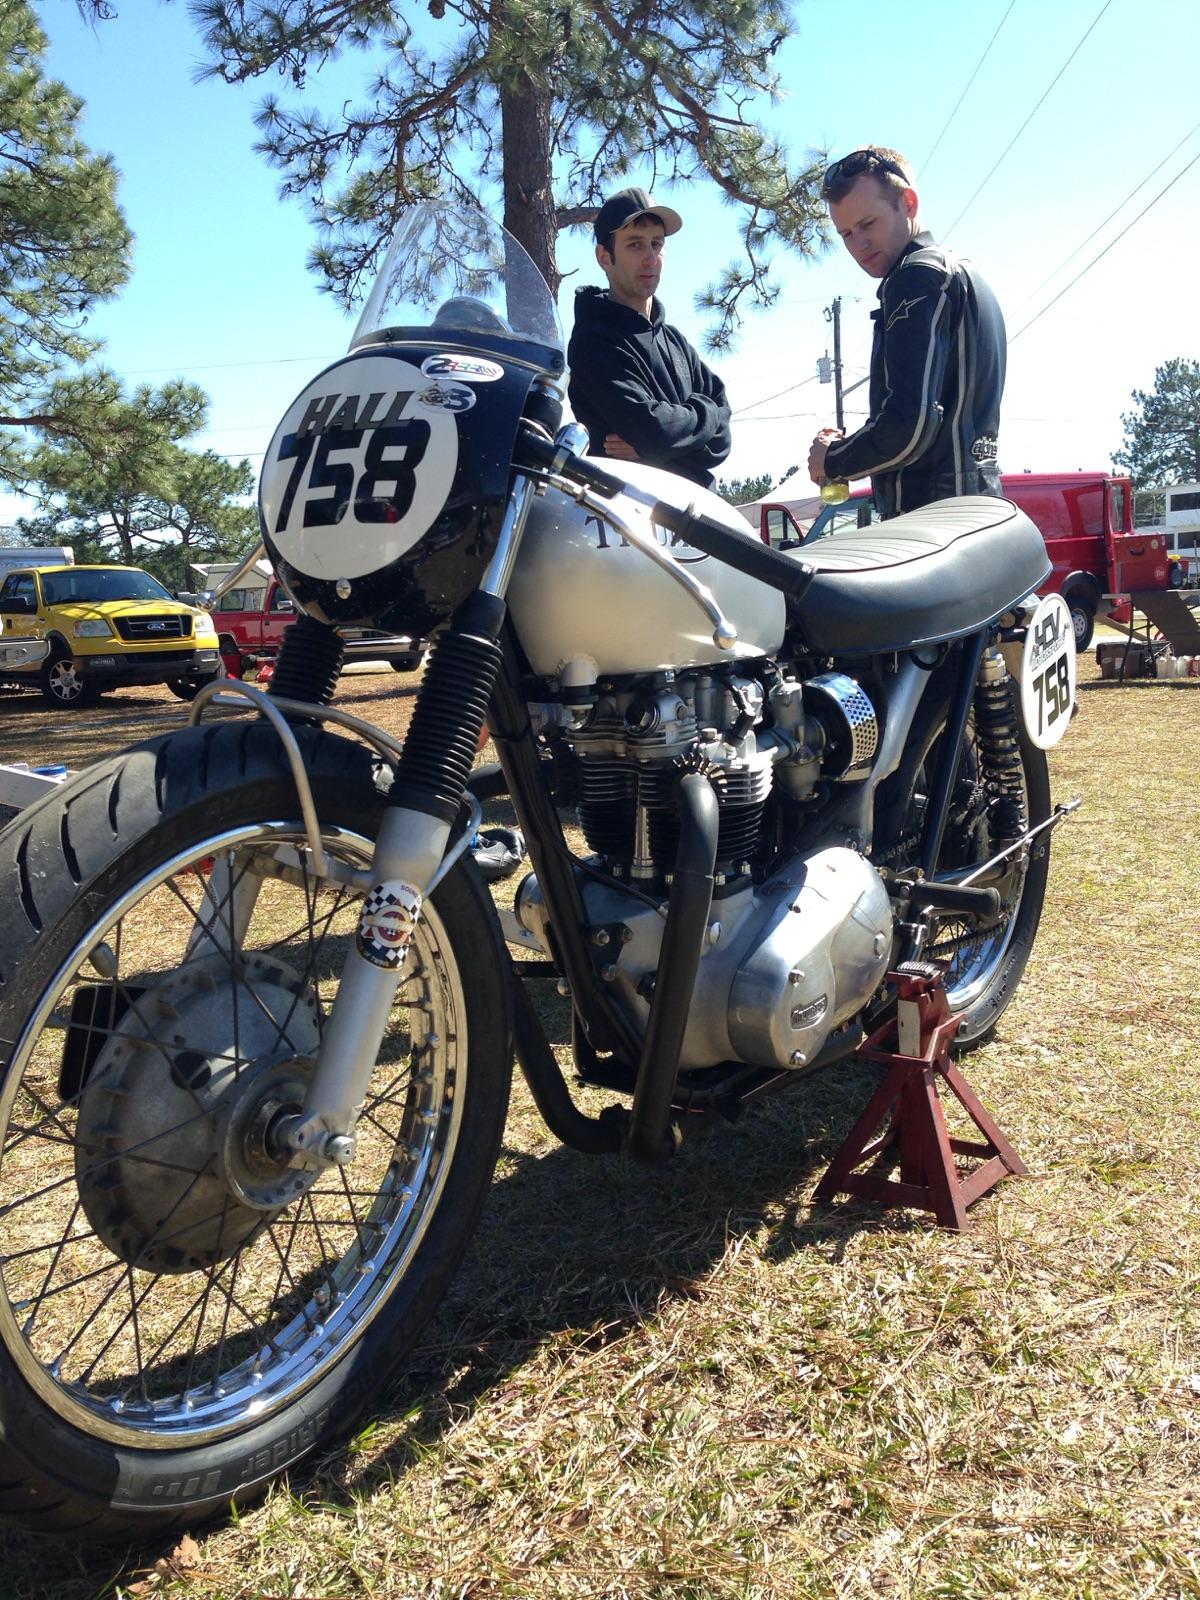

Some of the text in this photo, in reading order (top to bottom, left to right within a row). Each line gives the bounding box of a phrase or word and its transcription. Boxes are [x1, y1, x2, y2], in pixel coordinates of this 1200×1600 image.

[297, 391, 417, 439] HALL
[275, 419, 432, 533] 758
[1032, 652, 1070, 737] 758
